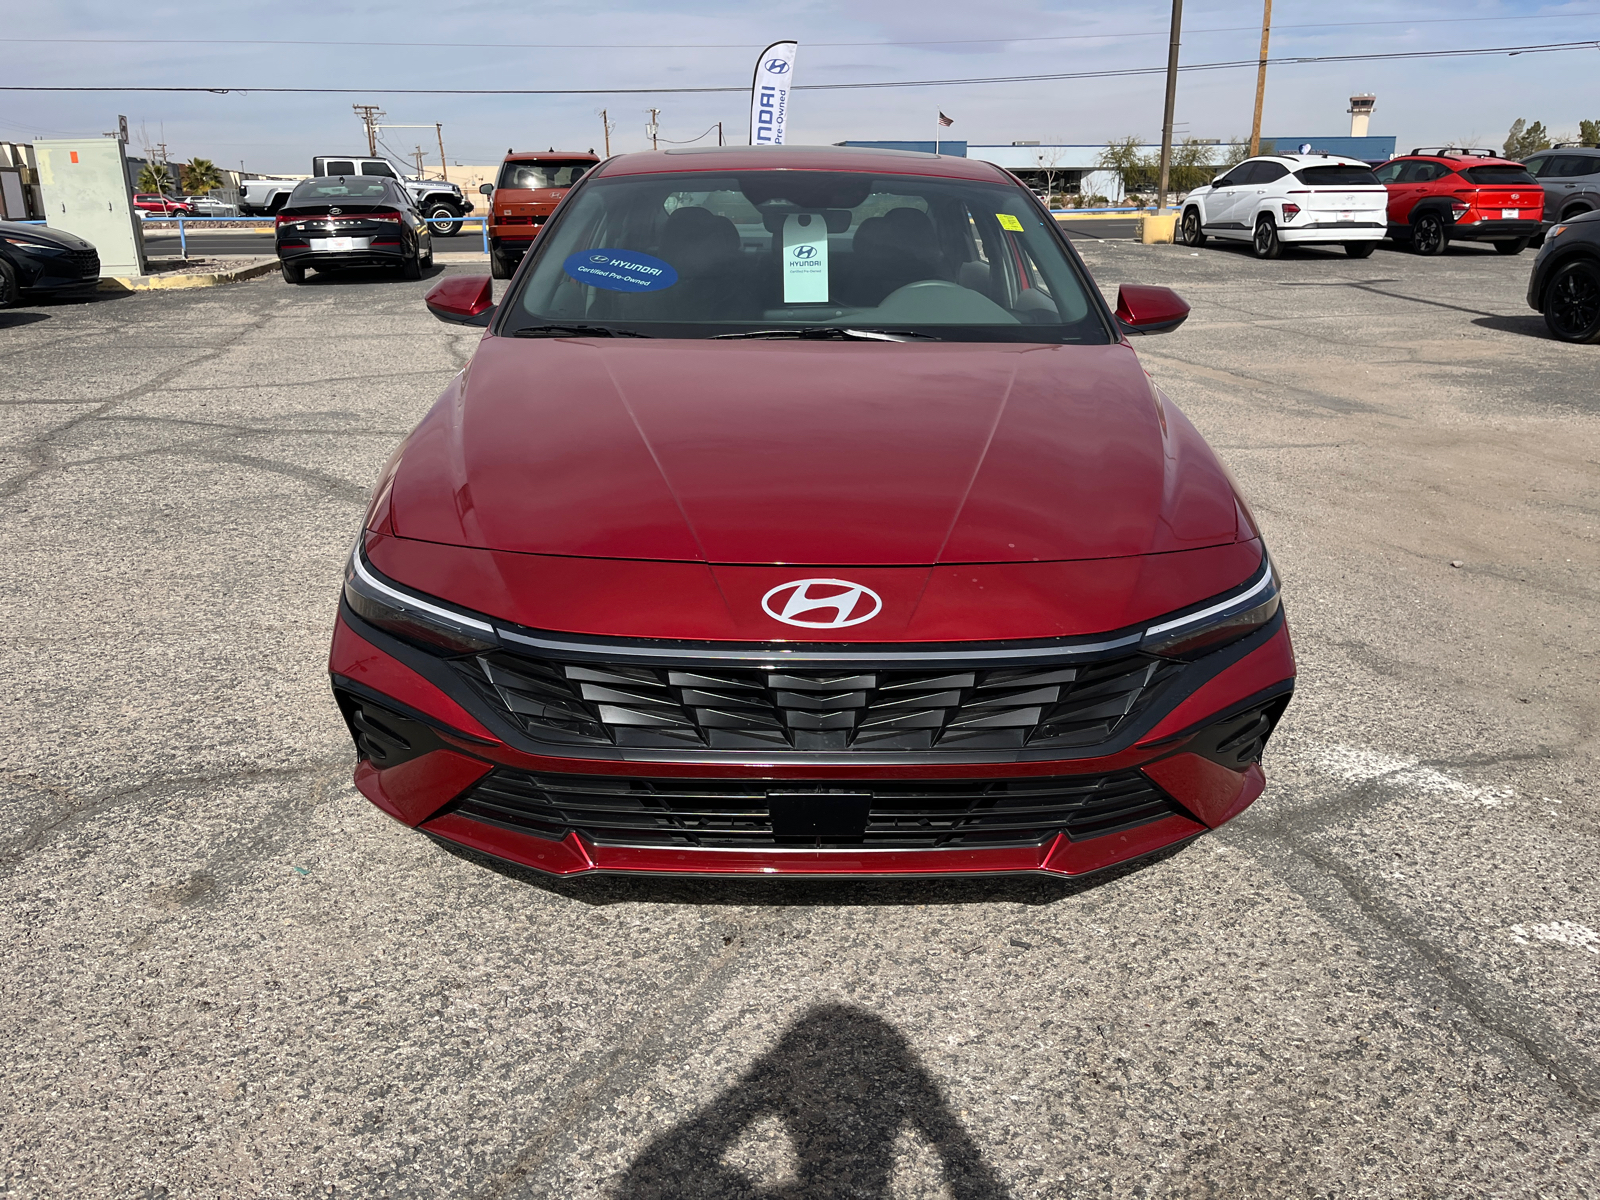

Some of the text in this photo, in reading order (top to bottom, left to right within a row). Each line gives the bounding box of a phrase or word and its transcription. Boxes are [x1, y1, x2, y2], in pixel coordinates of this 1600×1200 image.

[757, 86, 775, 145] NDAI
[775, 89, 786, 145] Pre-Owned
[577, 265, 651, 286] Certified Pre-Owned
[609, 259, 663, 276] HYUNDAI
